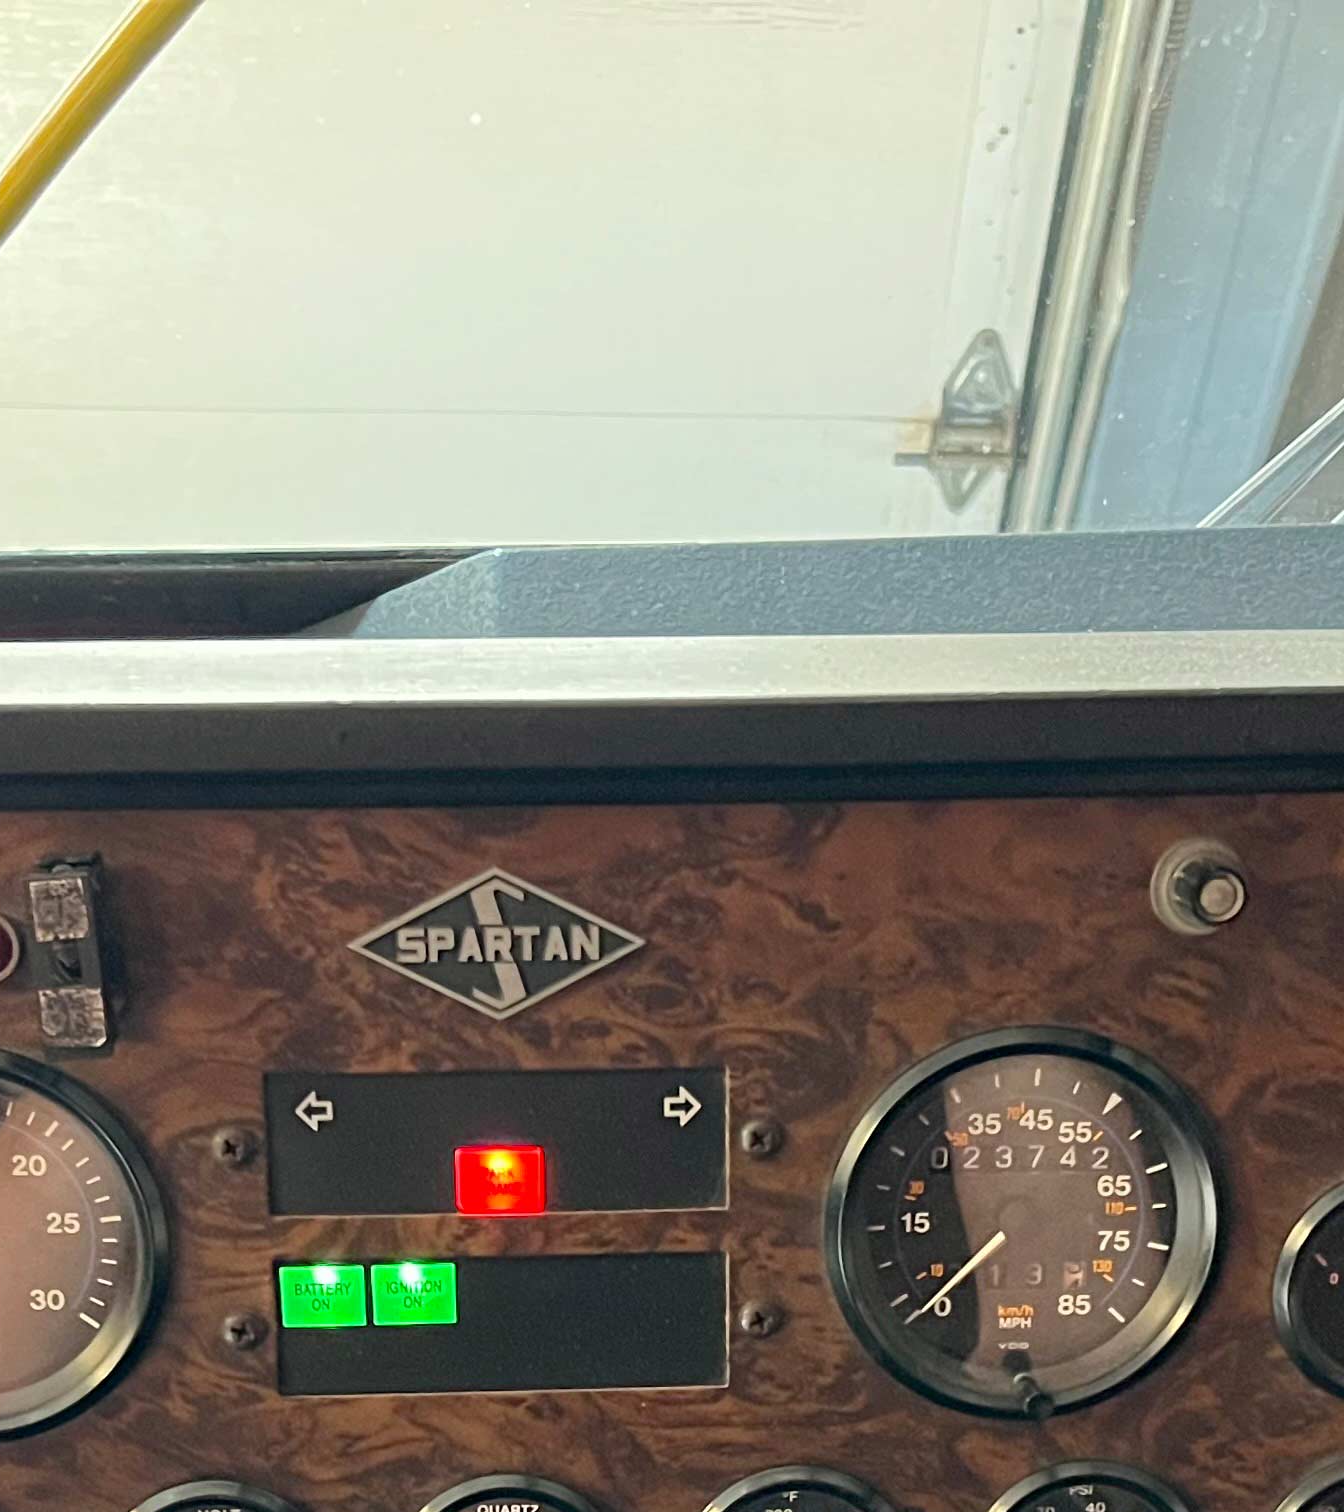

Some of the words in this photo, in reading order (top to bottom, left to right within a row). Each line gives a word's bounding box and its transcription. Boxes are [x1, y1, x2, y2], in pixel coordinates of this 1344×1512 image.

[396, 924, 600, 963] SPARTAN
[968, 1113, 1001, 1134] 35
[1019, 1109, 1053, 1130] 45
[1058, 1122, 1092, 1143] 55
[12, 1155, 47, 1176] 20
[1097, 1175, 1131, 1197] 65
[46, 1212, 80, 1235] 25
[901, 1212, 930, 1233] 15
[1097, 1230, 1130, 1252] 75
[294, 1282, 351, 1296] BATTERY
[386, 1280, 442, 1294] IGNITION
[1329, 1273, 1339, 1285] 0
[30, 1290, 65, 1311] 30
[311, 1298, 330, 1311] ON
[404, 1296, 422, 1309] ON
[934, 1297, 952, 1317] 0
[997, 1304, 1034, 1317] km/h
[1057, 1294, 1091, 1316] 85
[999, 1317, 1032, 1329] MPH
[1069, 1485, 1094, 1496] PSI
